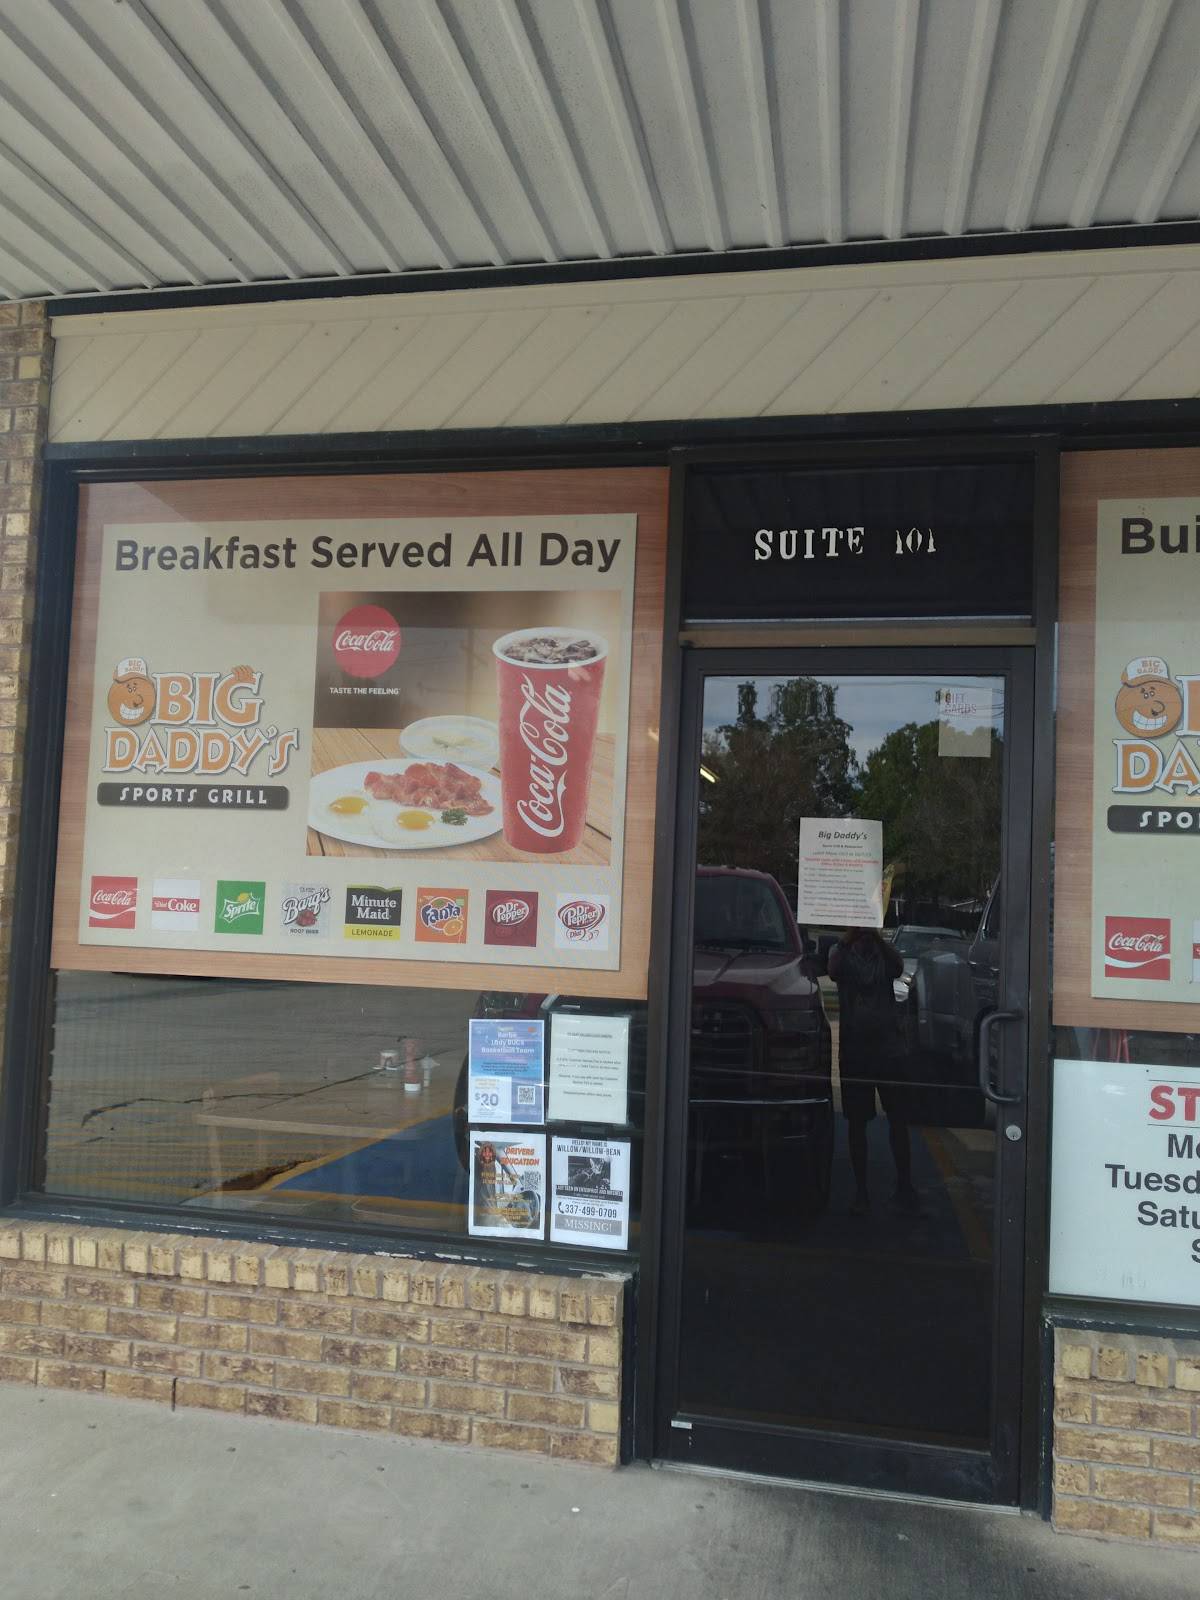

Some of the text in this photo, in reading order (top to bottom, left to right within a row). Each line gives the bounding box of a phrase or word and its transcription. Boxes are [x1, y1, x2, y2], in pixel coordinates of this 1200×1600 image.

[115, 531, 621, 573] Breakfast Served All Day
[754, 527, 937, 560] SUITE 101
[335, 630, 398, 651] Coca-Cola
[1140, 660, 1161, 668] BIG
[151, 672, 264, 727] BIG
[329, 687, 400, 695] TASTE THE FEELING
[102, 725, 299, 777] DADDY'S
[517, 672, 572, 838] Coca-Cola
[1112, 739, 1200, 795] DA
[119, 787, 268, 805] SPORTS GRILL
[1139, 811, 1200, 829] SPO
[818, 831, 868, 840] Big Daddy's
[93, 890, 133, 906] Coca-Cola
[168, 899, 197, 912] Coke
[281, 887, 331, 925] Barq's
[351, 894, 397, 909] Minute
[223, 898, 257, 919] Sprite
[357, 906, 390, 920] Maid
[421, 902, 462, 927] Fanta
[497, 904, 525, 922] Pepper
[506, 903, 518, 912] Dr
[567, 907, 597, 926] Pepper
[576, 906, 589, 916] Dr
[351, 928, 394, 937] LEMONADE
[1108, 932, 1167, 952] Coca-Cola
[475, 1092, 499, 1107] $20
[505, 1146, 535, 1155] DRIVERS
[1167, 1134, 1200, 1159] M
[565, 1204, 617, 1218] 337-499-0709
[564, 1219, 612, 1232] MISSING!
